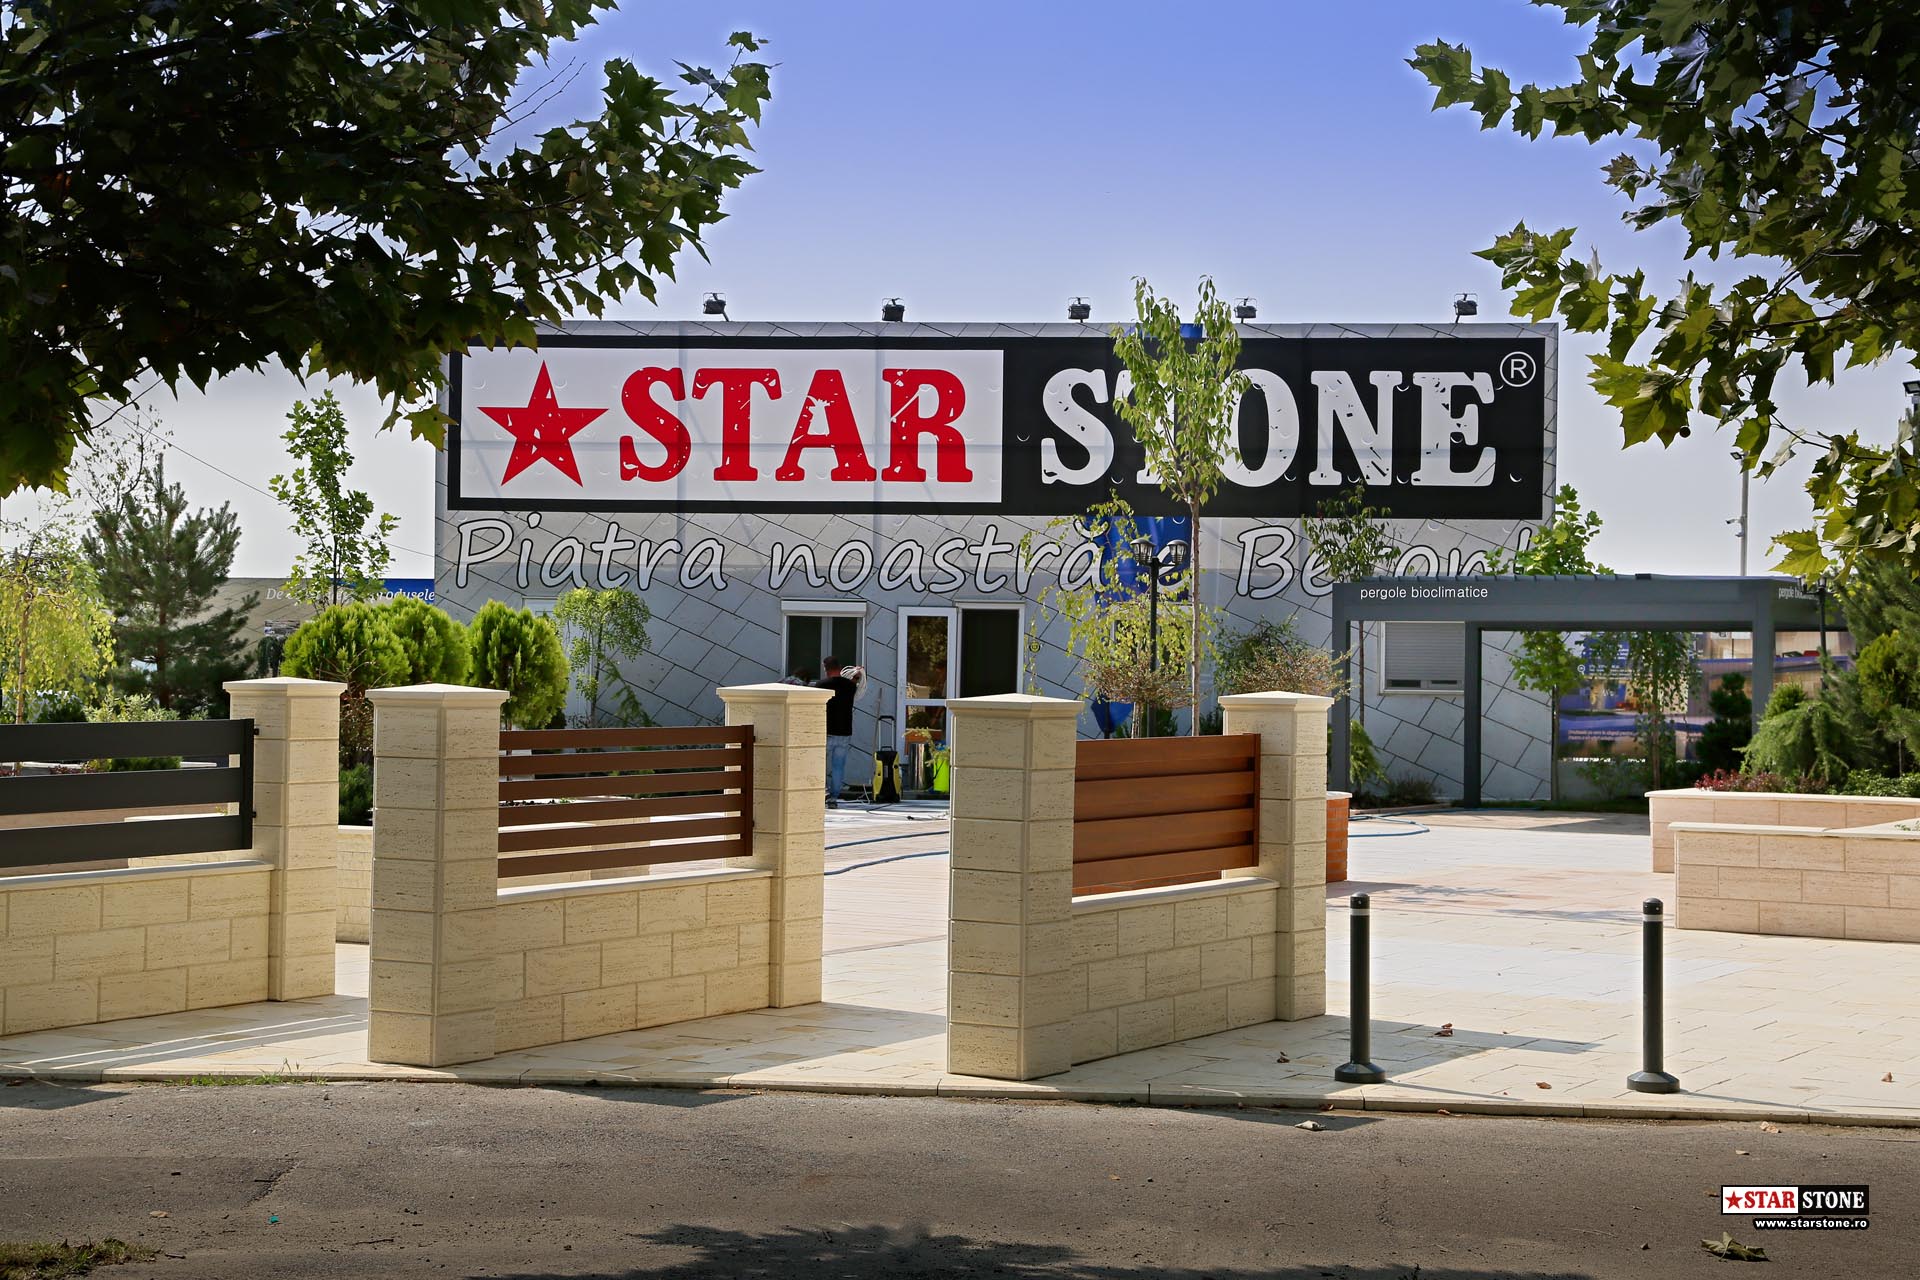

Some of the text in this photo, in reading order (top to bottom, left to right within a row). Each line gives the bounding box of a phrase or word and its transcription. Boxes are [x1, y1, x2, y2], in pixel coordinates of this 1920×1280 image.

[619, 366, 974, 483] STAR
[456, 511, 728, 591] Piatra
[769, 519, 1107, 593] noastră
[265, 588, 284, 600] De
[1360, 586, 1488, 601] pergole bioclimatice
